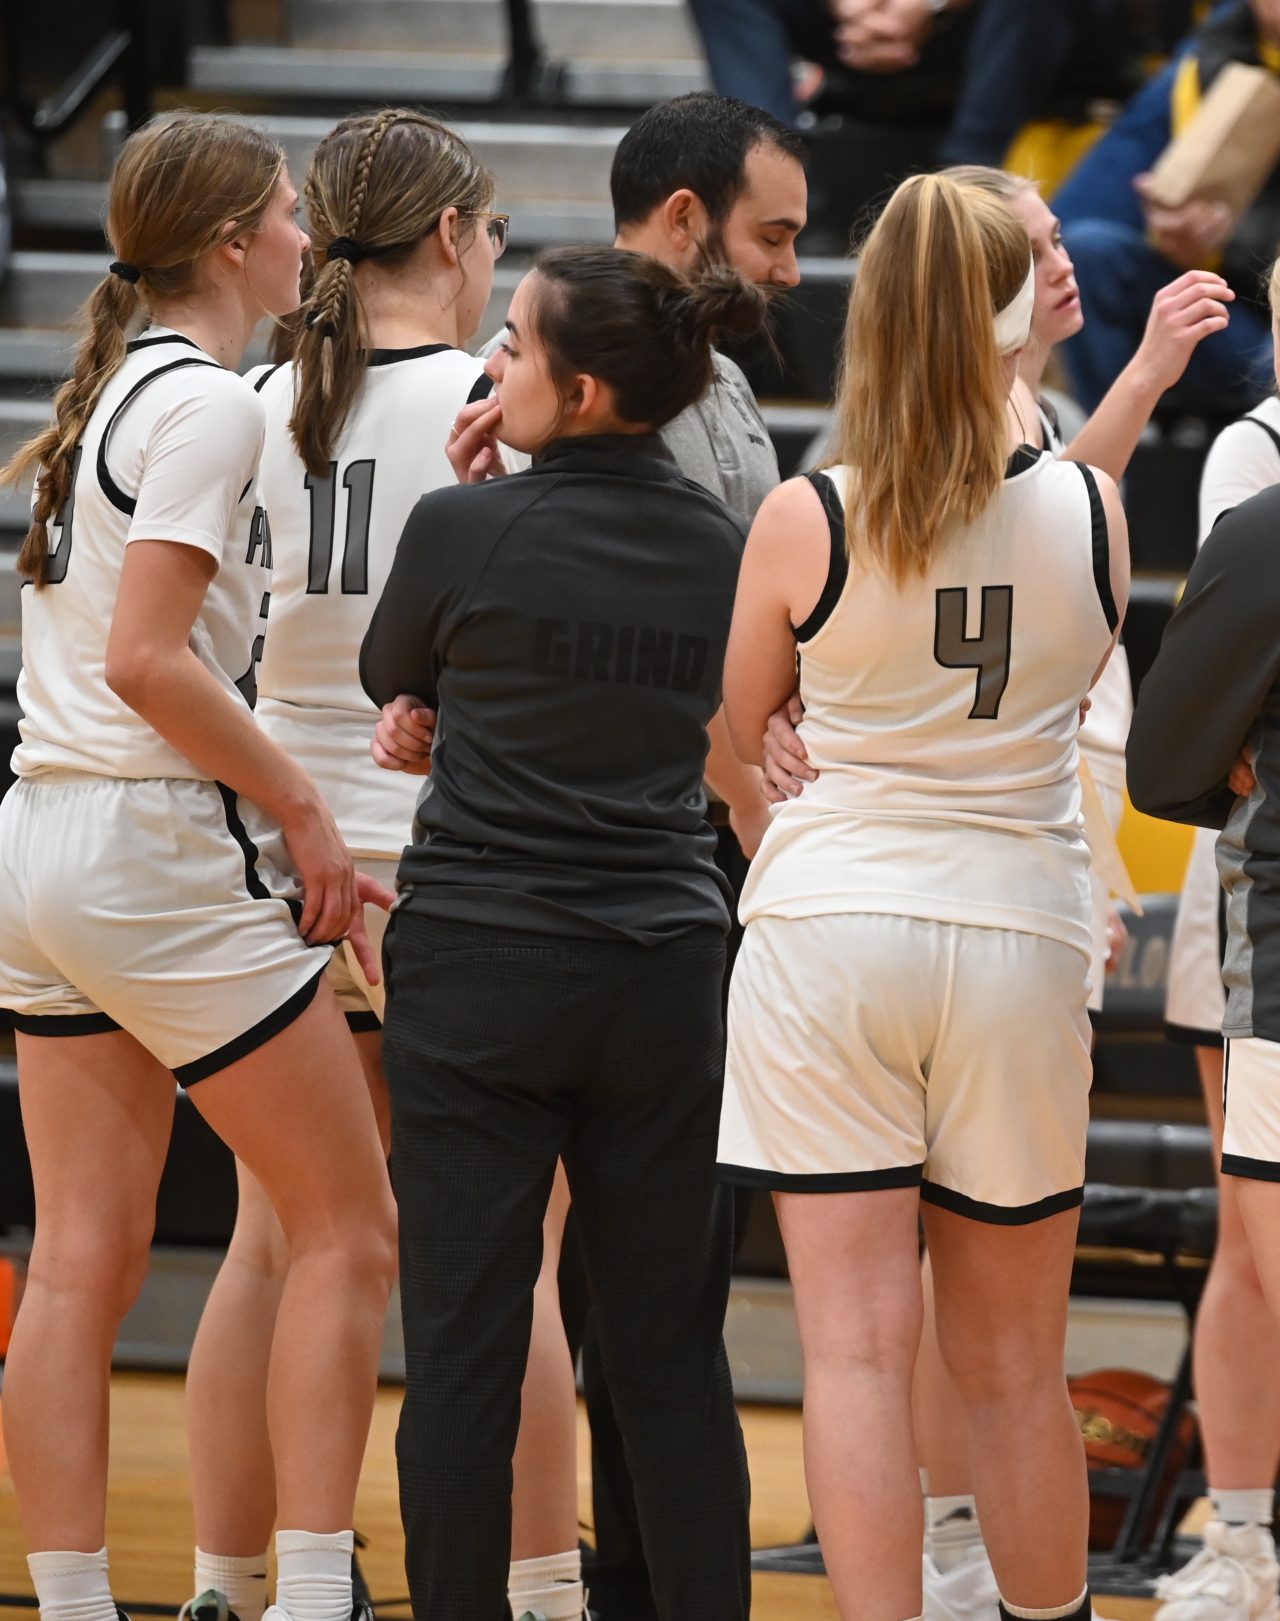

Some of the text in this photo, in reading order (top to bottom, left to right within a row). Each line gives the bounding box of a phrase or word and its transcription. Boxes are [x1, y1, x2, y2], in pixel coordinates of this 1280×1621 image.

[304, 459, 376, 594] 11
[531, 617, 710, 694] GRIND
[934, 584, 1013, 719] 4
